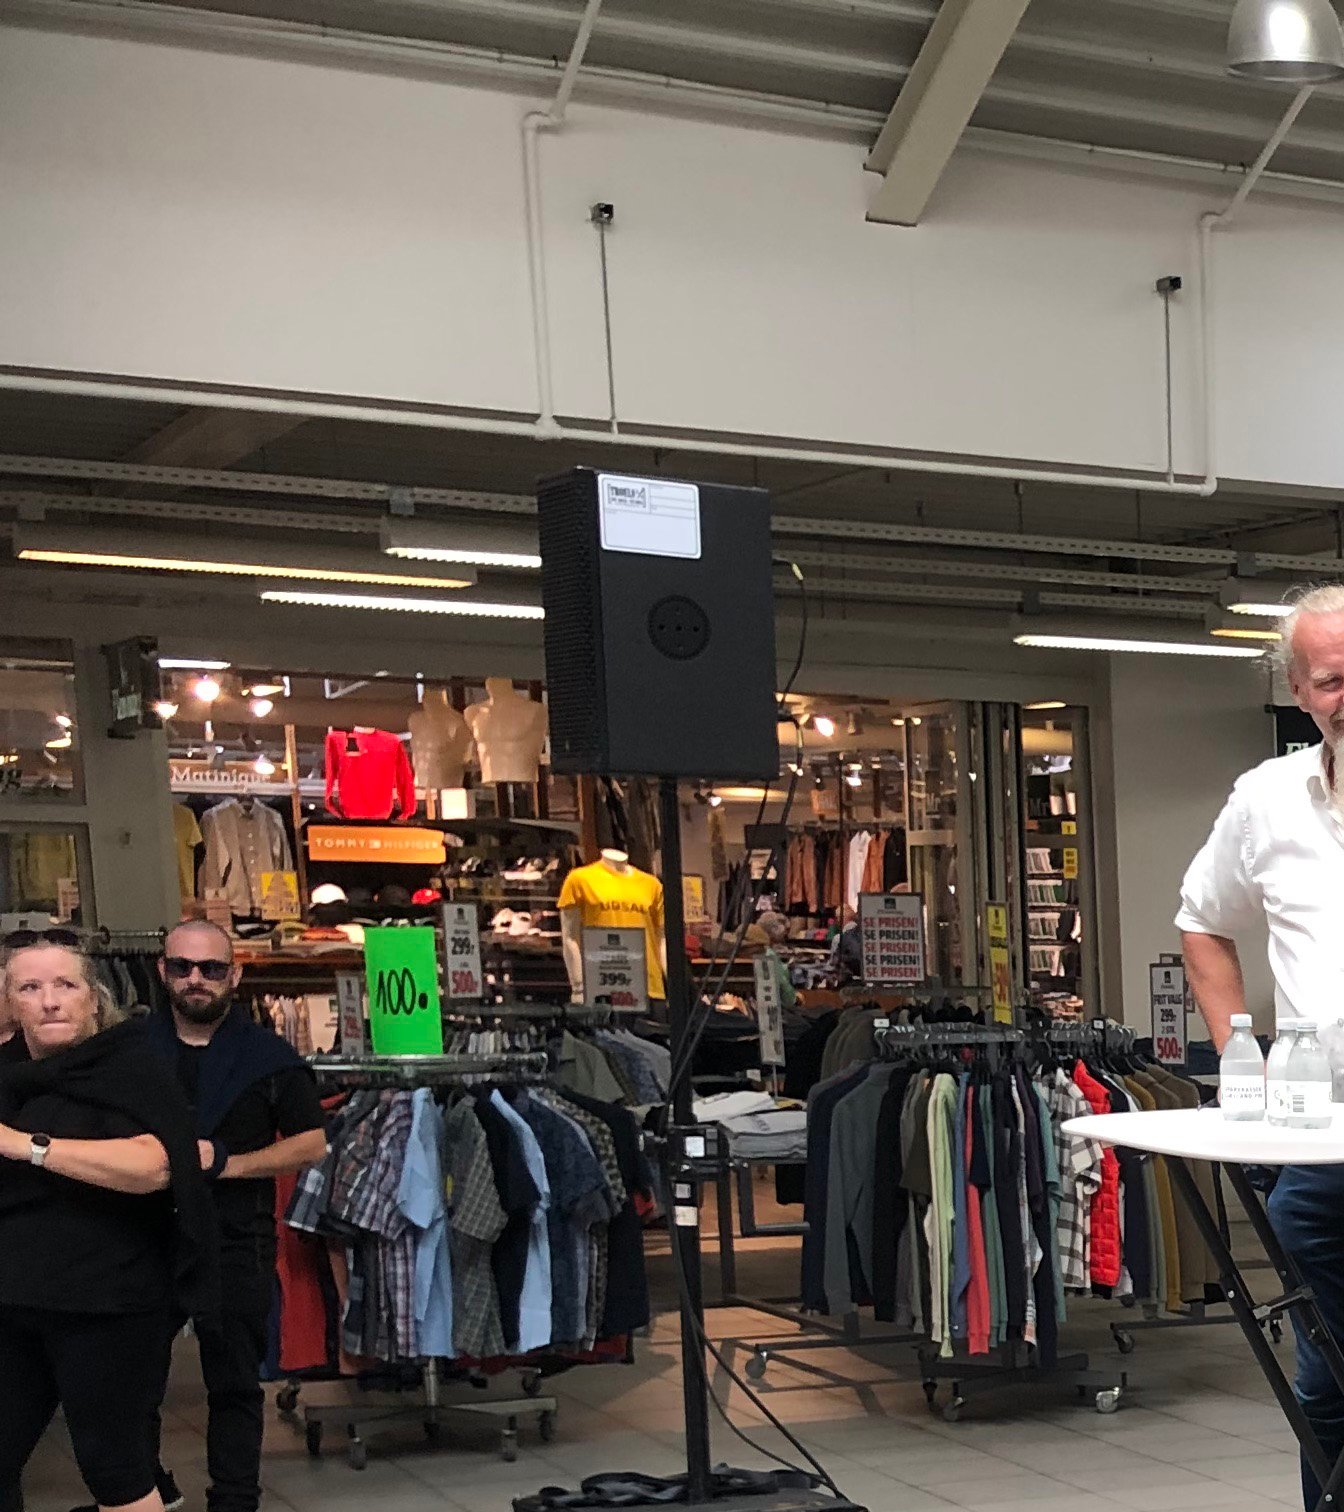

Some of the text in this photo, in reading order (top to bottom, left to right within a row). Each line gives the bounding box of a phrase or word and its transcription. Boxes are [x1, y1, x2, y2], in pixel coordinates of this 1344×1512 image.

[316, 838, 366, 848] TOMMY
[864, 917, 918, 927] SE PRISEN!
[865, 930, 919, 940] SE PRISEN!
[865, 942, 919, 953] SE PRISEN!
[866, 955, 920, 965] SE PRISEN!
[866, 967, 921, 978] SE PRISEN!
